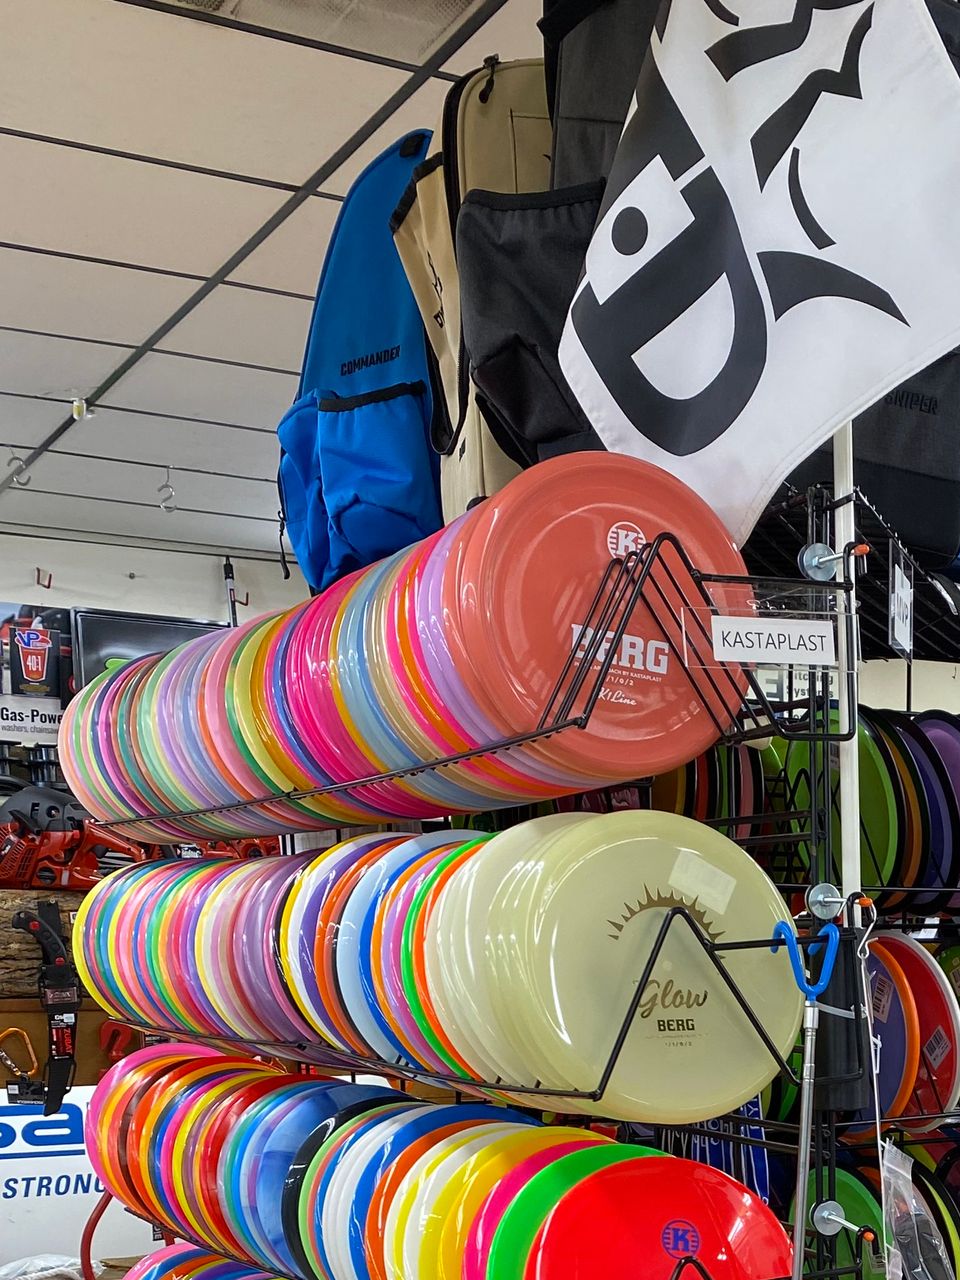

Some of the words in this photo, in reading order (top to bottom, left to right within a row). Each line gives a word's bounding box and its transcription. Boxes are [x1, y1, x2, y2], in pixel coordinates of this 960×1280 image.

[340, 344, 401, 377] COMMANDER
[884, 389, 938, 416] SNIPER
[721, 630, 827, 652] KASTAPLAST
[632, 979, 709, 1018] Glow
[657, 1018, 695, 1032] BERG
[63, 1028, 73, 1054] ZUBAT
